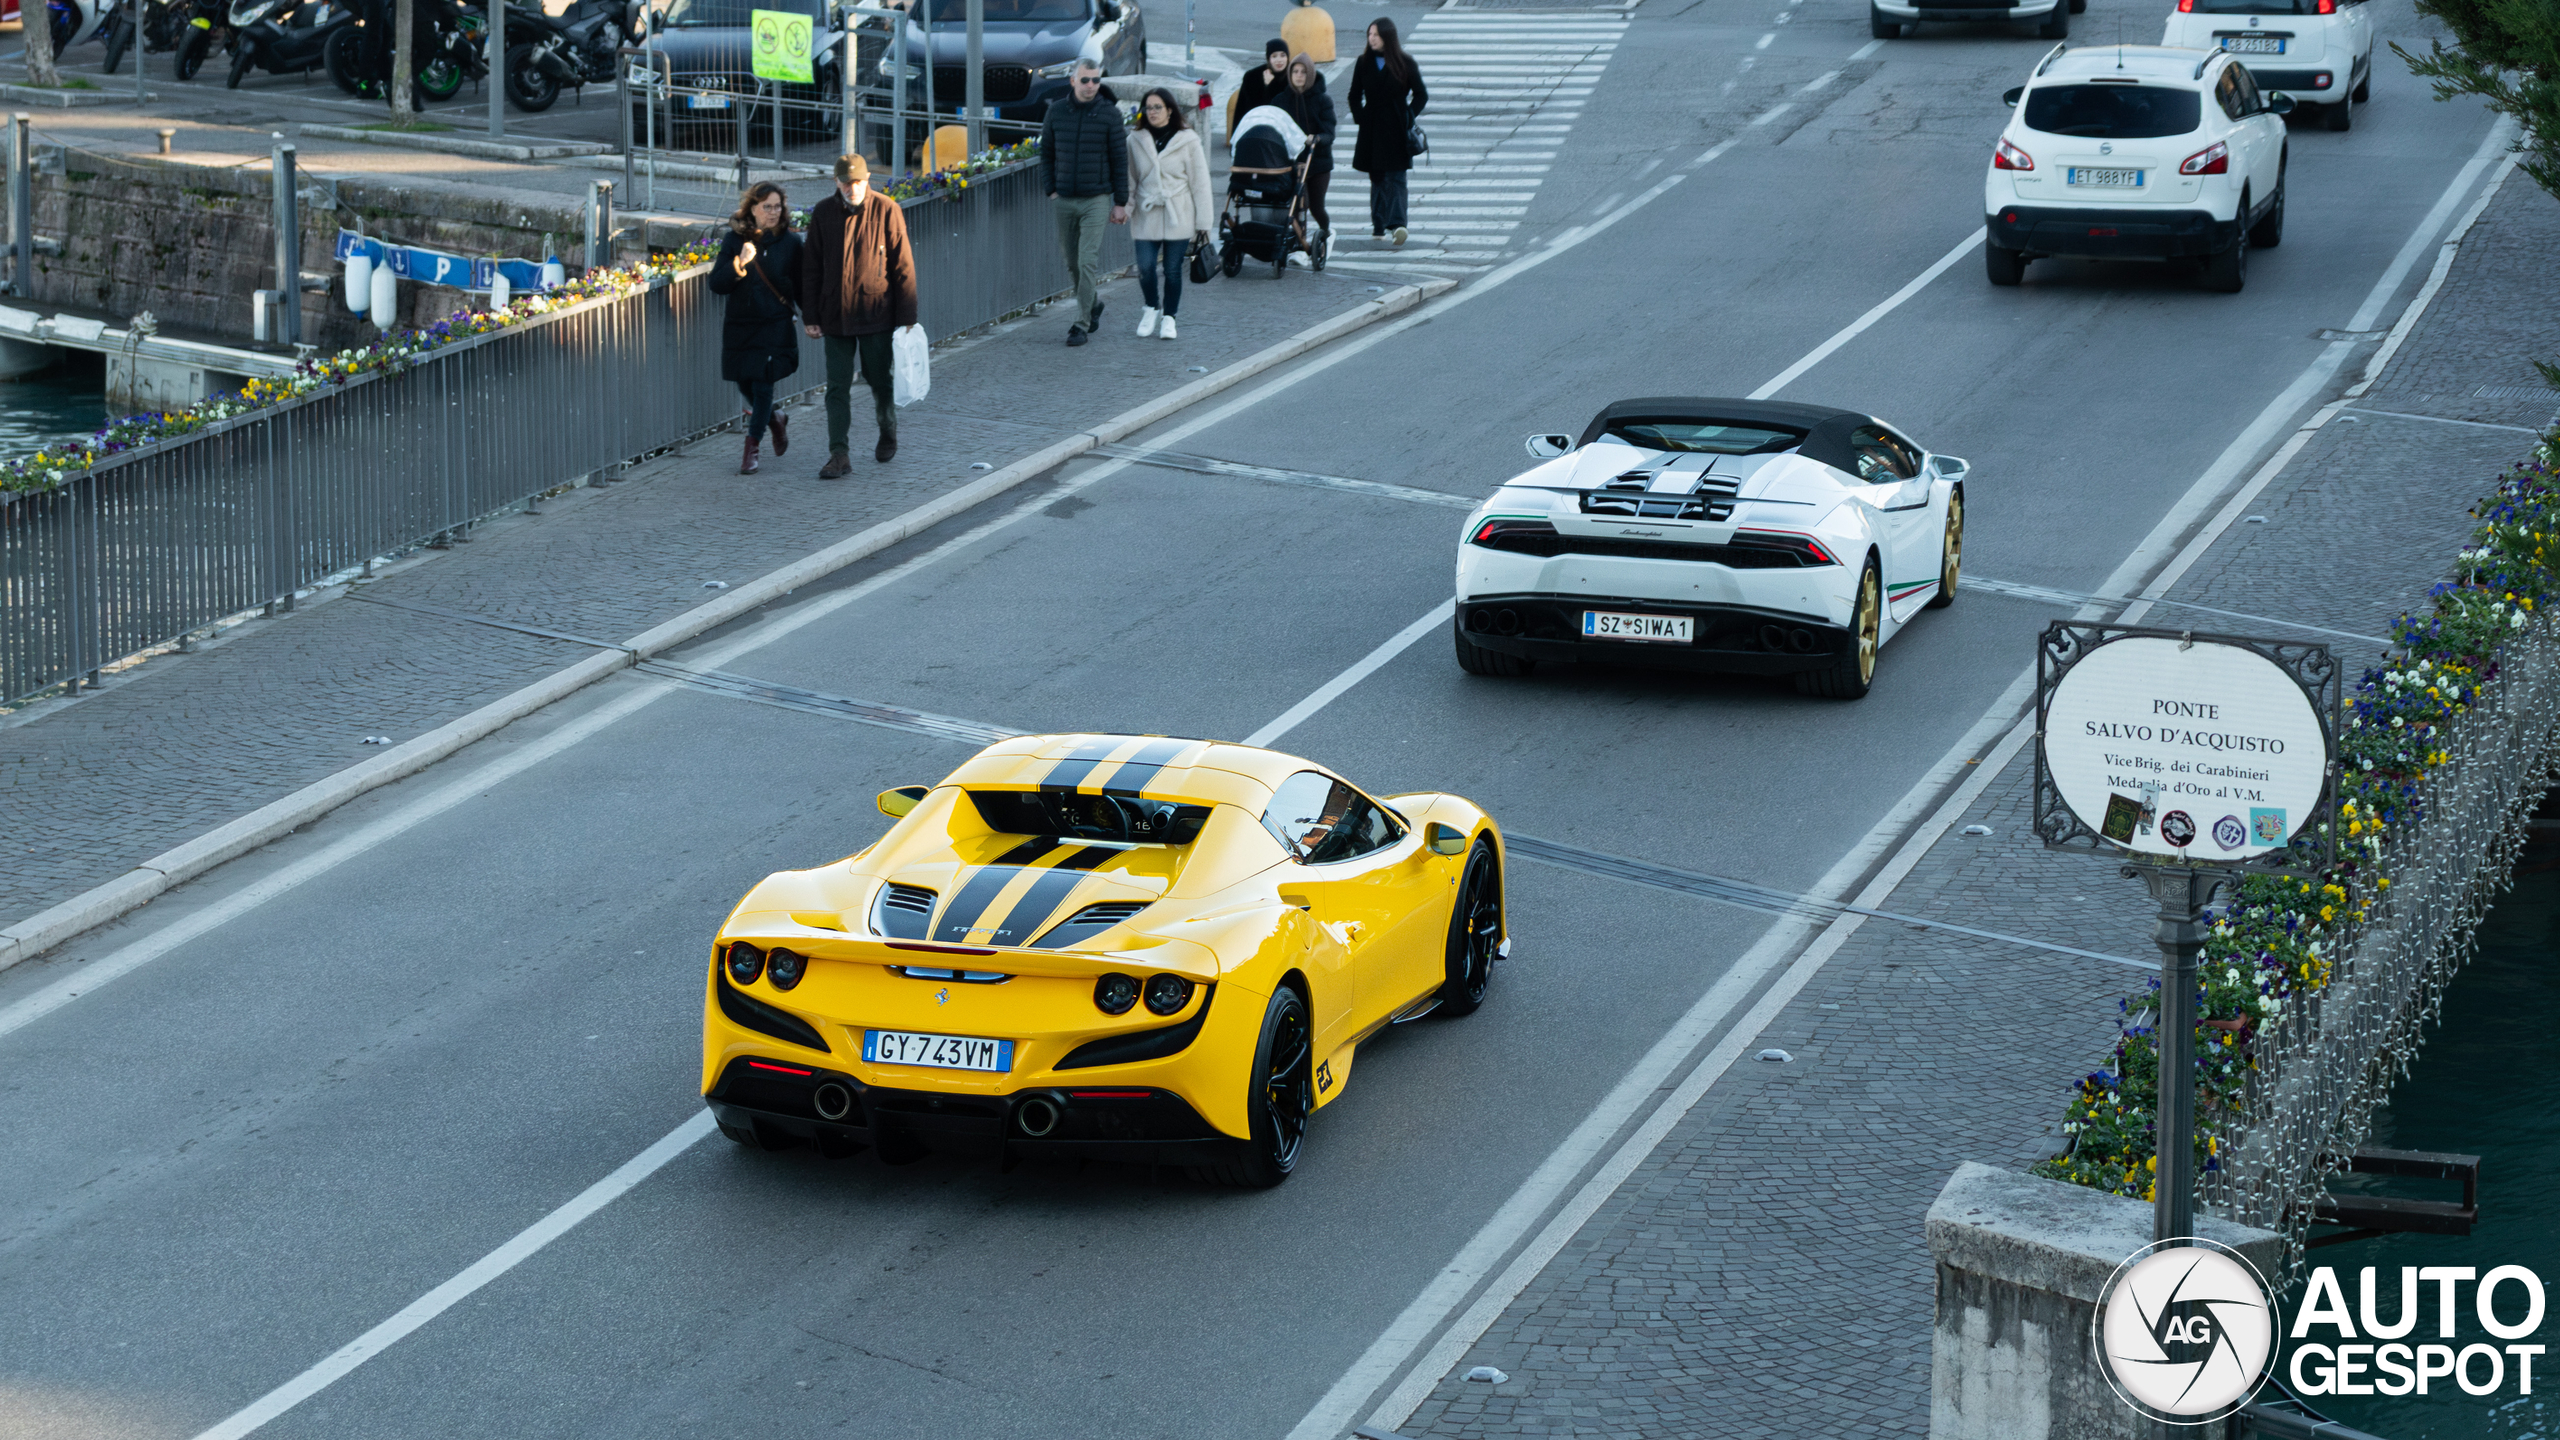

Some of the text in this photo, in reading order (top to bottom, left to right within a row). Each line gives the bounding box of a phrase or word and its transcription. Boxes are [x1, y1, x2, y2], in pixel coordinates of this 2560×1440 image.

[2077, 170, 2135, 185] ET 988YF
[434, 257, 451, 282] P
[1600, 616, 1620, 633] SZ
[1633, 618, 1674, 637] SIWA
[2153, 699, 2219, 720] PONTE
[2086, 721, 2285, 754] SALVO D'ACQUISTO
[2104, 753, 2269, 781] Vice Brig. dei Carabinieri
[2107, 775, 2167, 792] Medalia
[2173, 782, 2211, 796] d'Oro
[2216, 787, 2227, 798] al
[2233, 788, 2265, 802] V.M.
[881, 1034, 910, 1061] GY
[916, 1037, 994, 1068] 743VM
